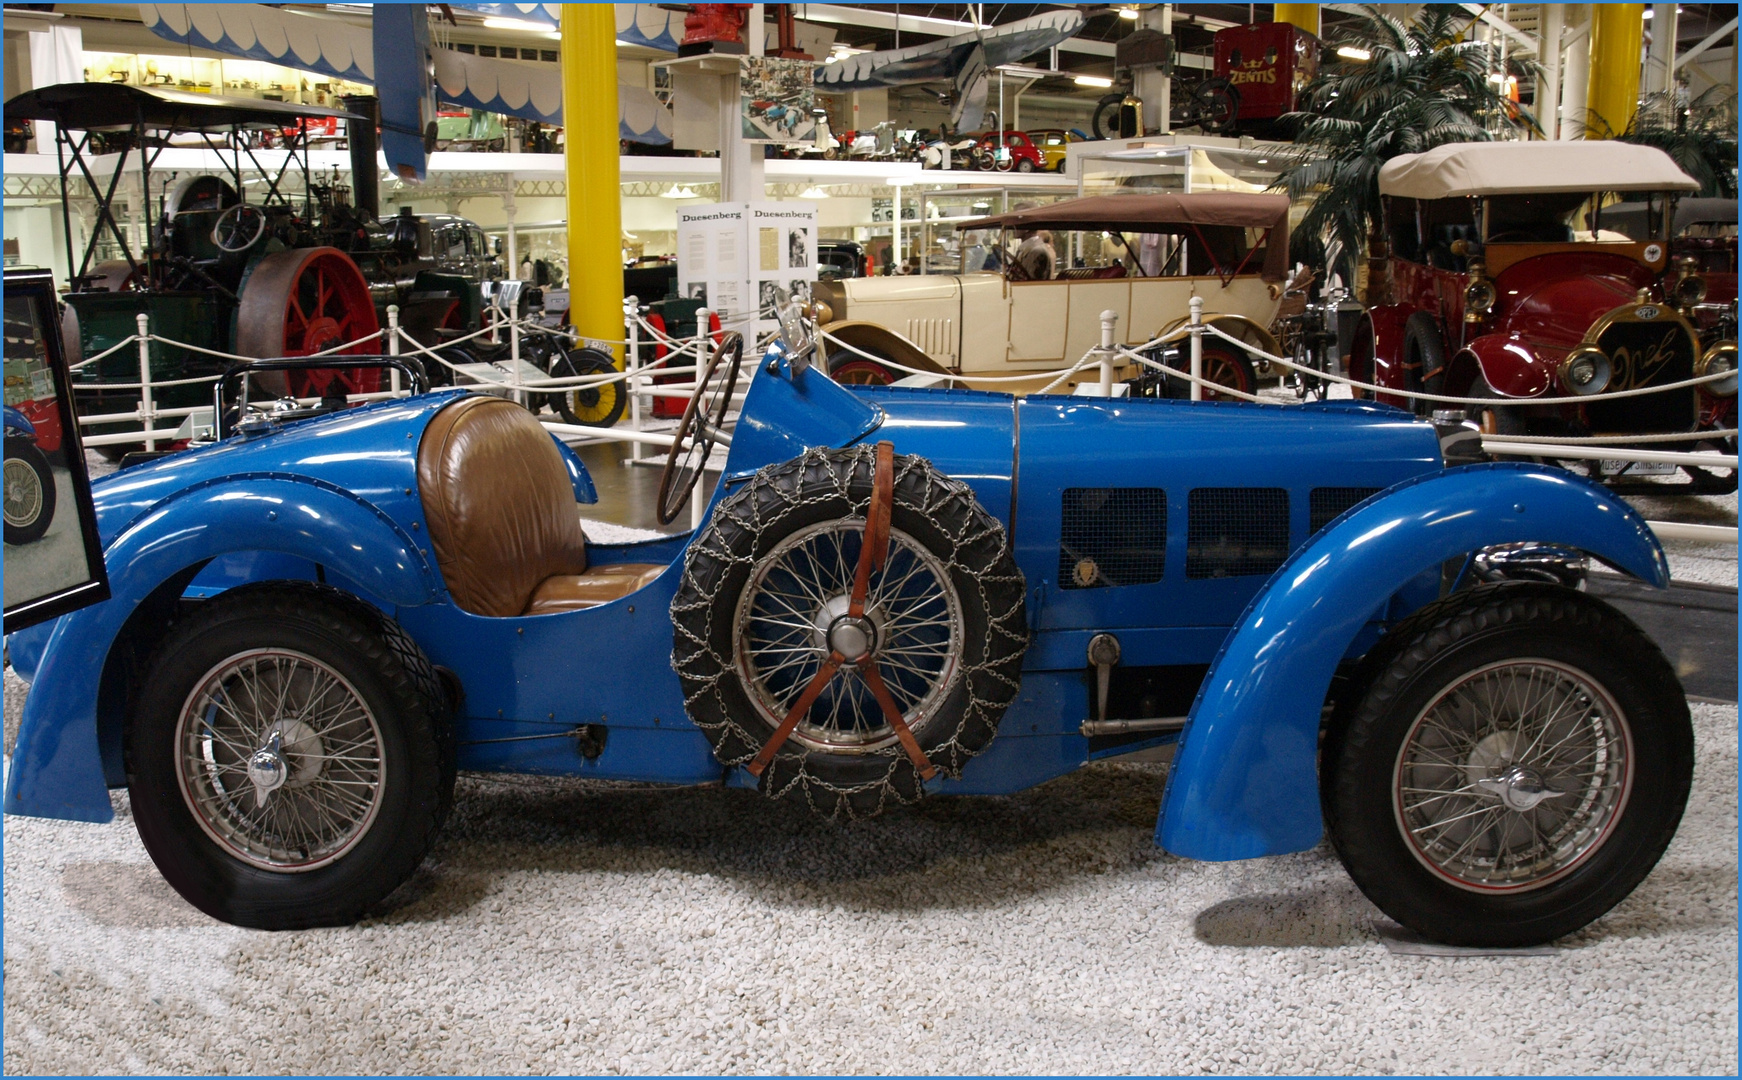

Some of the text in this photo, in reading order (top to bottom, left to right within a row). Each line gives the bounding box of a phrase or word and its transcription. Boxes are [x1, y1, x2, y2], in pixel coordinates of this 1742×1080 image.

[1230, 68, 1277, 85] ZENTIS
[682, 211, 742, 222] Duesenberg
[754, 210, 813, 220] Duesenberg
[1609, 327, 1677, 391] Opel
